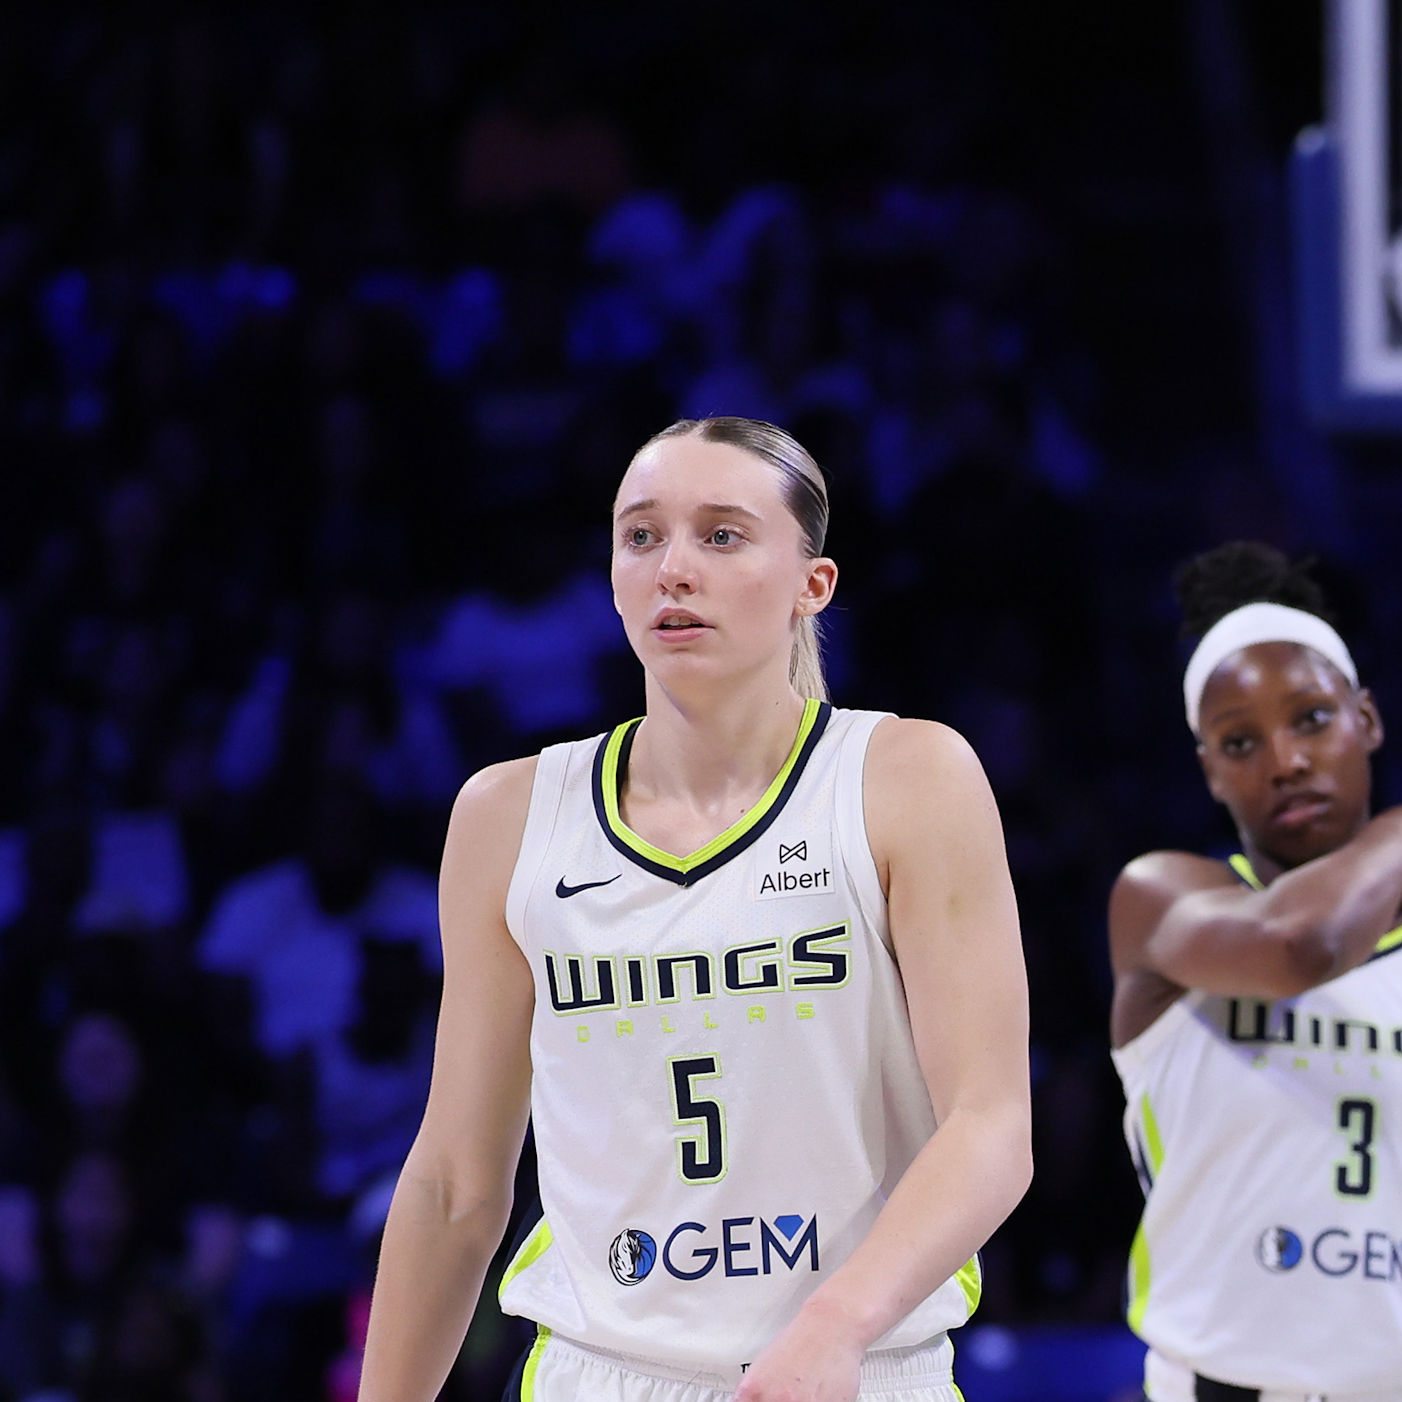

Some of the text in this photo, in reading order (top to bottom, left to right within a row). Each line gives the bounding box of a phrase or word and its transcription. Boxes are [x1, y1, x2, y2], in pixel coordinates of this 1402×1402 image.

[760, 868, 831, 894] Albert
[543, 920, 852, 1016] WINGS
[576, 1002, 815, 1043] DALLAS
[667, 1052, 728, 1185] 5
[1334, 1095, 1378, 1199] 3
[662, 1213, 819, 1281] GEM
